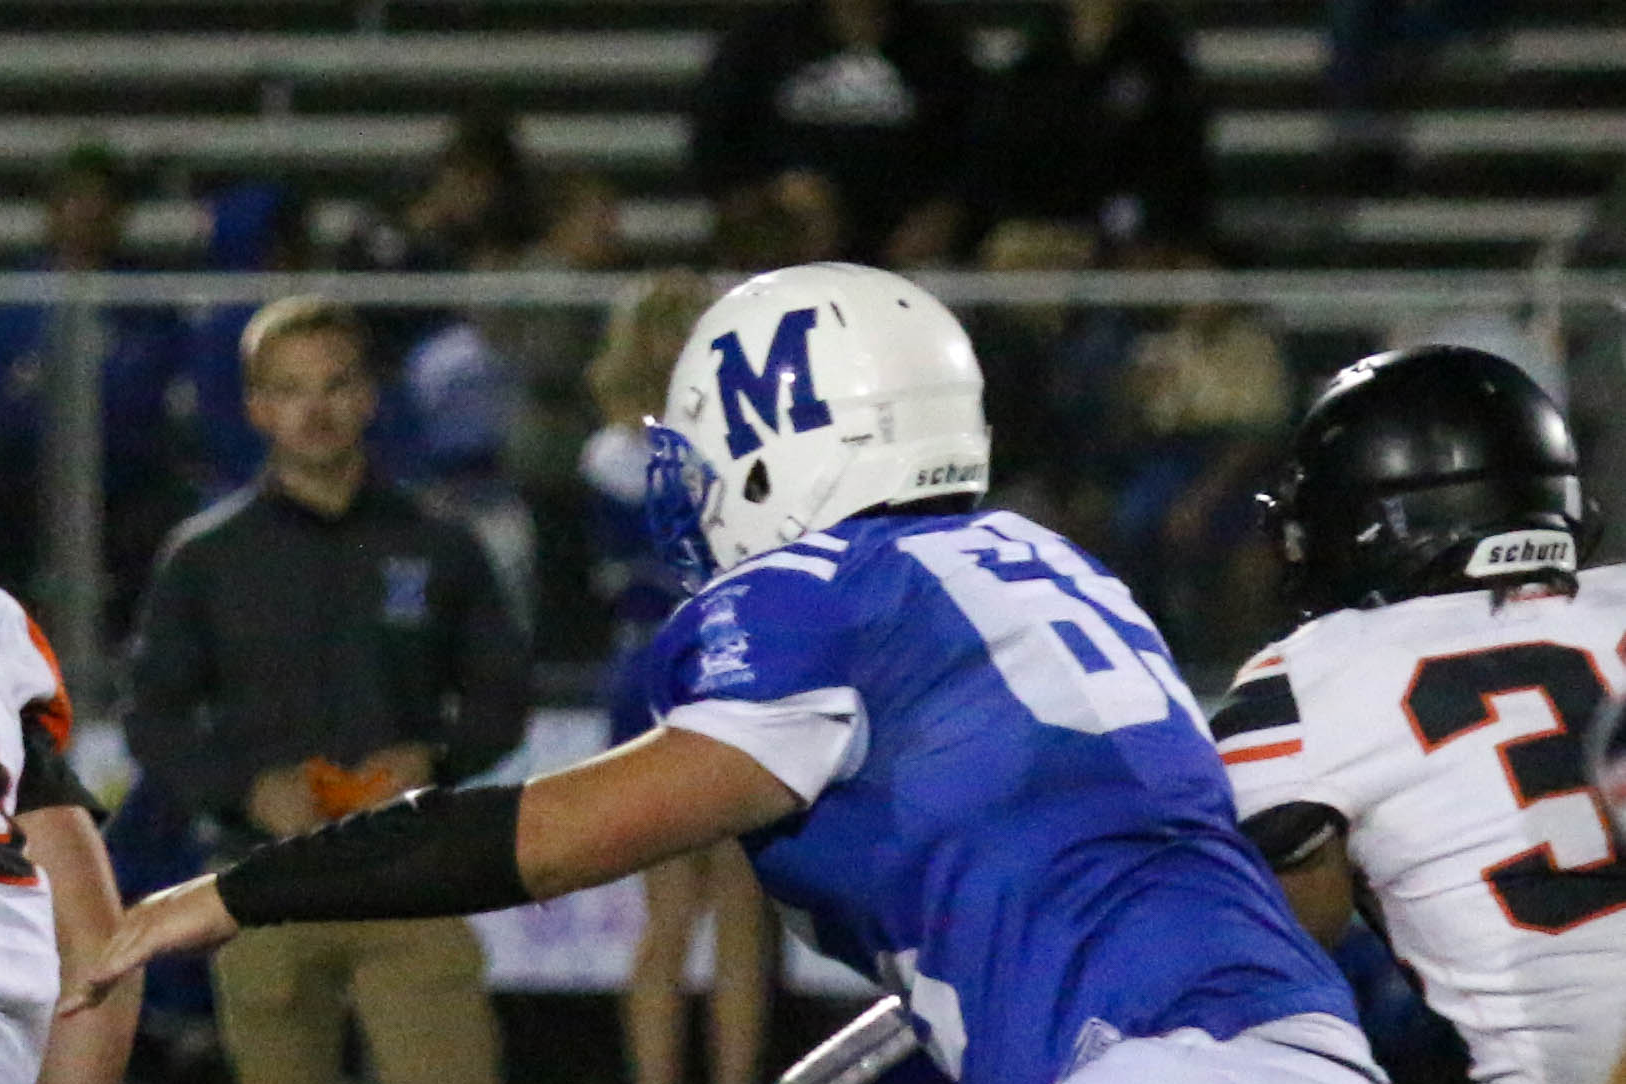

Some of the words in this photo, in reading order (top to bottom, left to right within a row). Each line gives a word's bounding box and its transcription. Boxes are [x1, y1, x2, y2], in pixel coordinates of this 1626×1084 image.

[711, 307, 833, 459] M
[1489, 538, 1568, 564] schutt
[1401, 641, 1626, 935] 3
